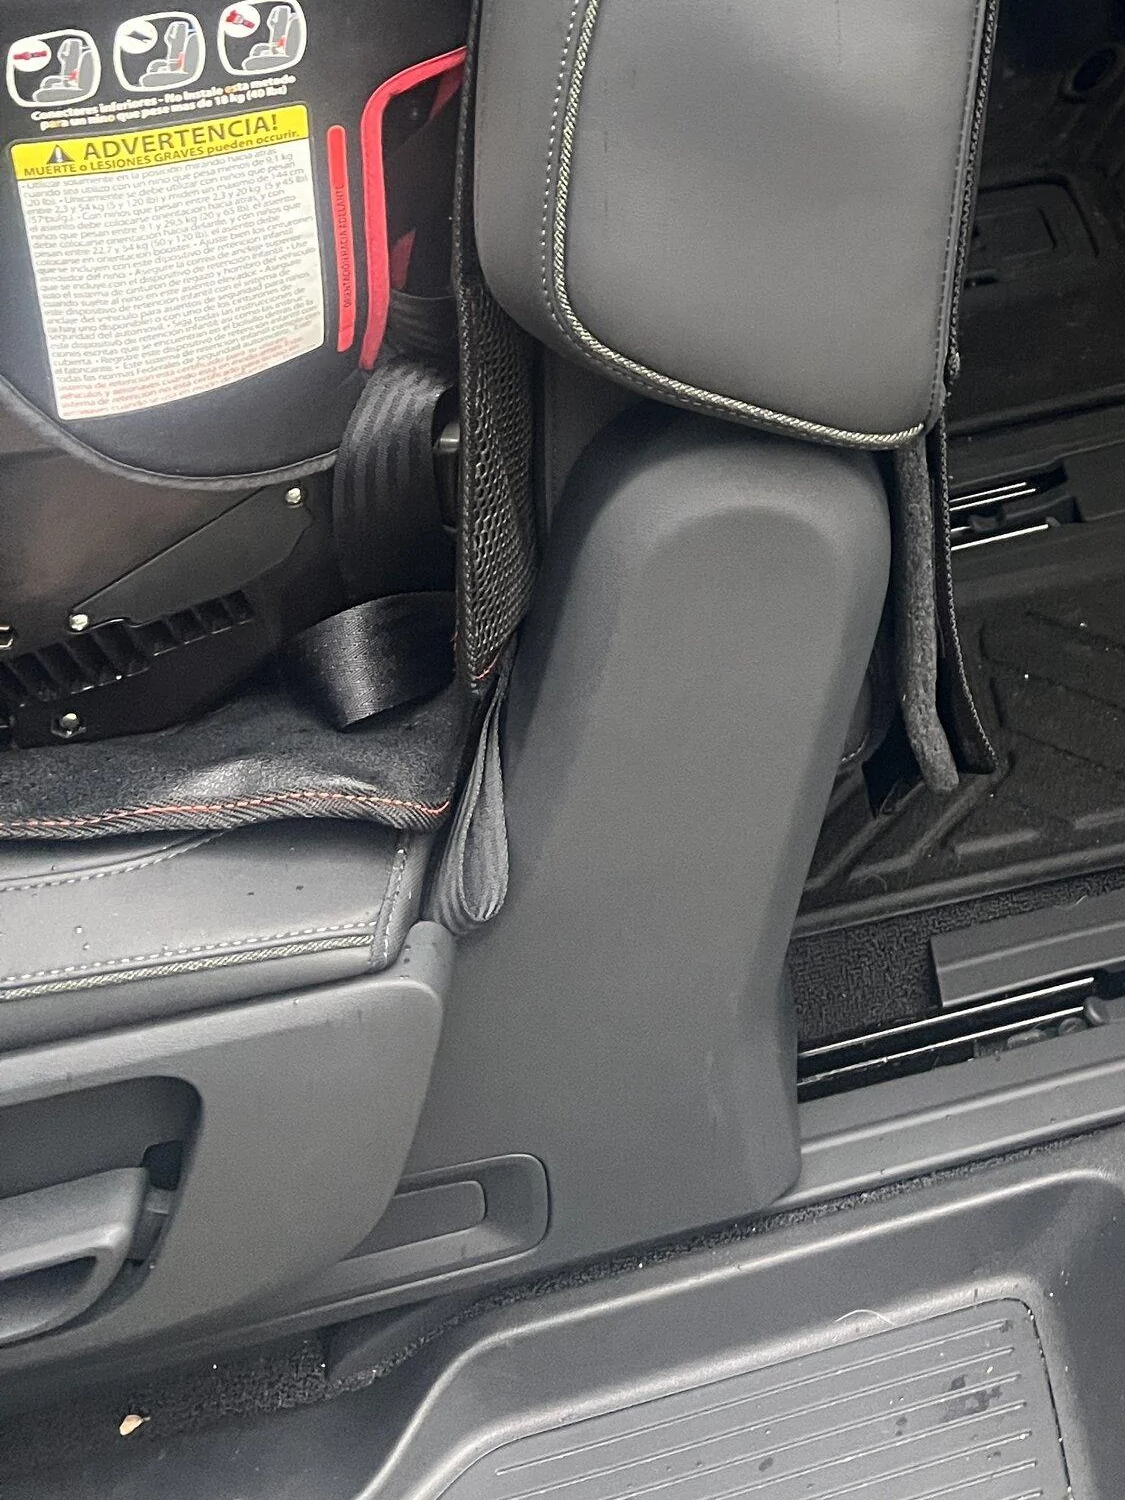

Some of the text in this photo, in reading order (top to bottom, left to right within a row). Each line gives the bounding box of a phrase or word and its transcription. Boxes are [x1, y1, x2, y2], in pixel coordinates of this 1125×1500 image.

[24, 164, 77, 176] MUERTE
[90, 155, 152, 171] LESIONES
[154, 147, 205, 162] GRAVES
[207, 139, 254, 155] pueden
[83, 114, 277, 161] ADVERTENCIA!
